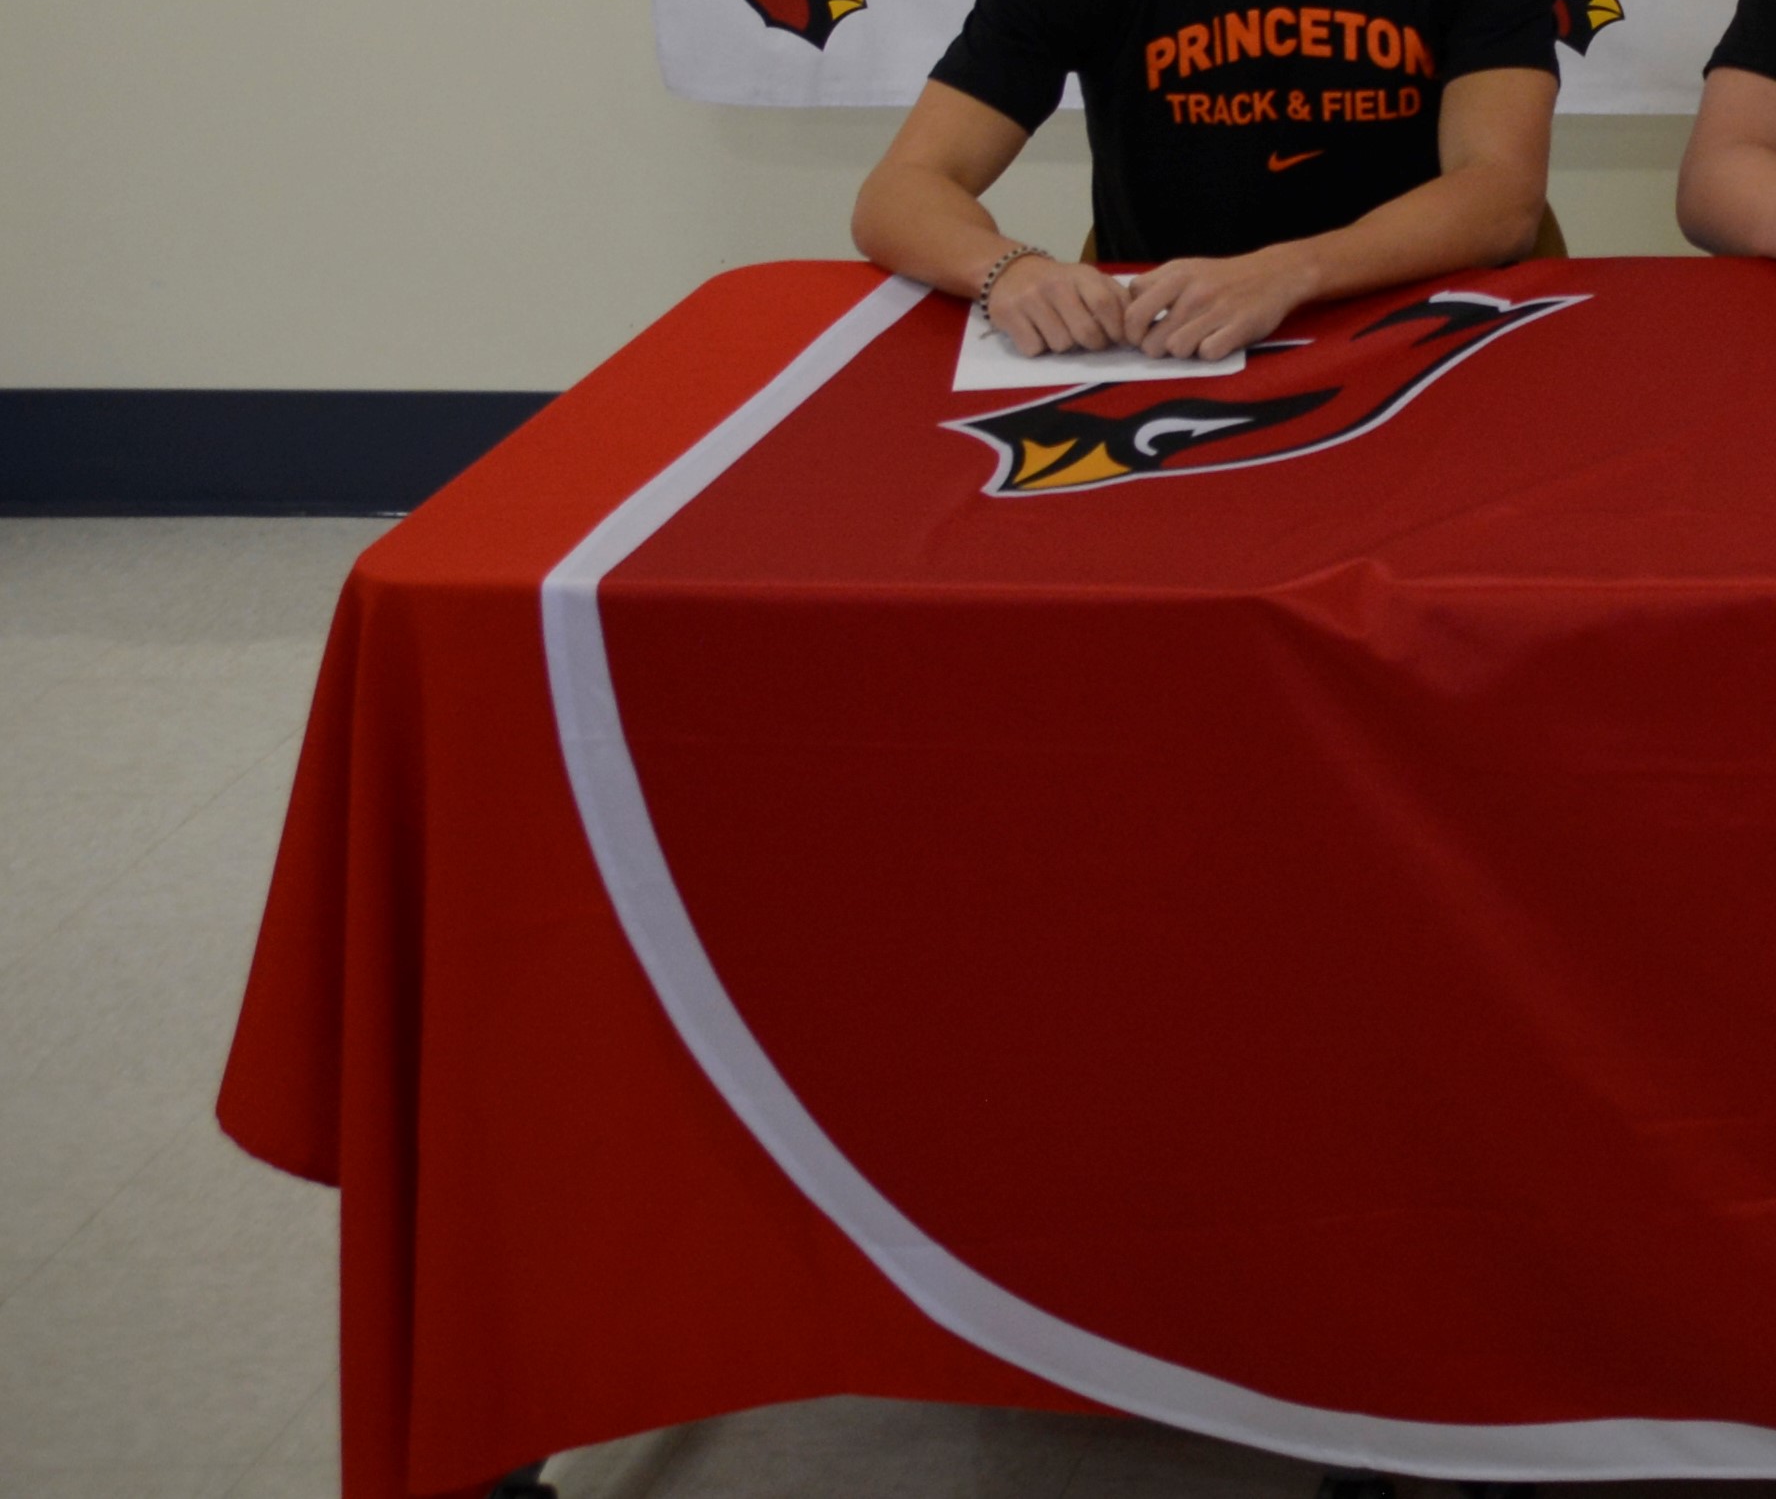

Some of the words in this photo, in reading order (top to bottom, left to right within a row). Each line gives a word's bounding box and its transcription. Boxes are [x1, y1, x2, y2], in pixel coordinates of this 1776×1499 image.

[1145, 6, 1437, 92] PRINCETON
[1165, 90, 1279, 126] TRACK
[1287, 89, 1312, 121] &
[1322, 87, 1422, 121] FIELD
